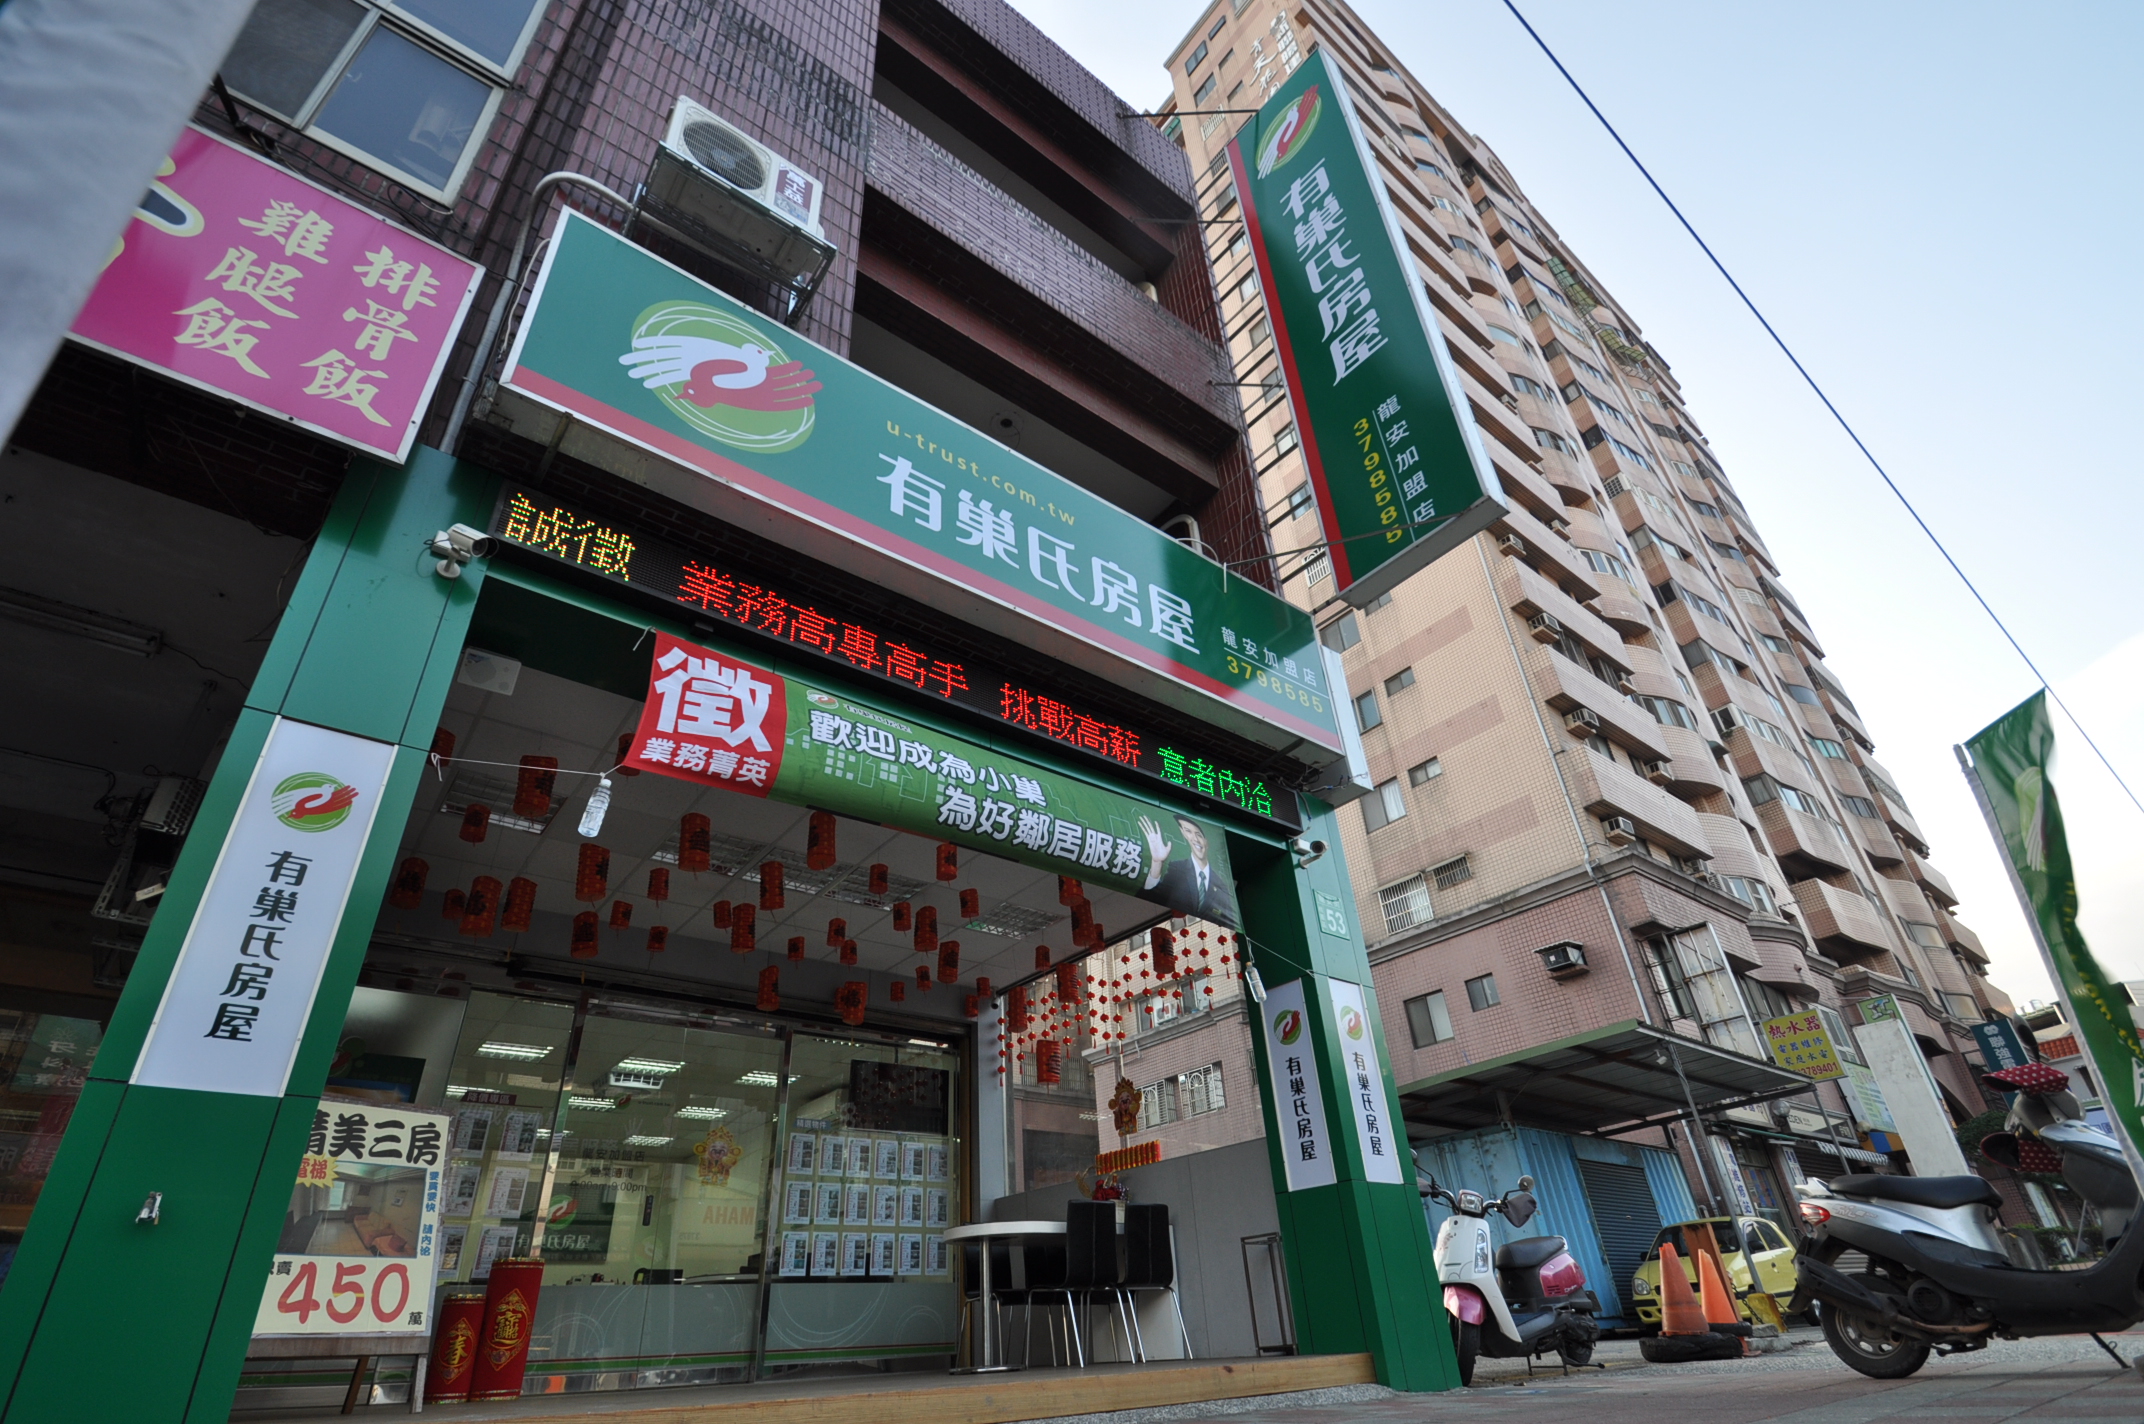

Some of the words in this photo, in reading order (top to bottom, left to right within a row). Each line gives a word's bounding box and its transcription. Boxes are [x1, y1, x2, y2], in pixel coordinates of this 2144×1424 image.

[172, 198, 335, 379] 雞腿飯
[1280, 157, 1388, 387] 有巢氏房屋
[301, 245, 442, 427] 排骨飯
[886, 419, 1076, 527] u-trust.com.tw
[1353, 417, 1403, 543] 3798585
[1376, 393, 1436, 528] 龍安加盟店
[875, 452, 1201, 655] 有巢氏房屋
[504, 492, 636, 581] 誠徵
[1000, 682, 1142, 768] 挑戰高薪
[1221, 626, 1318, 687] 龍安加盟店
[653, 646, 773, 753] 徵
[1226, 655, 1324, 713] 3798585
[639, 736, 771, 788] 業務菁英
[808, 708, 1048, 808] 歡迎成為小巢
[936, 785, 1144, 880] 為好鄰居服務
[203, 850, 314, 1043] 有巢氏房屋
[1326, 908, 1346, 935] 53
[1768, 1015, 1821, 1040] 熱水器
[582, 1149, 646, 1162] 龍安加盟店
[1285, 1056, 1318, 1162] 有巢氏房屋
[1352, 1051, 1384, 1157] 有巢氏房屋
[277, 1261, 410, 1325] 450
[407, 1311, 423, 1326] 萬
